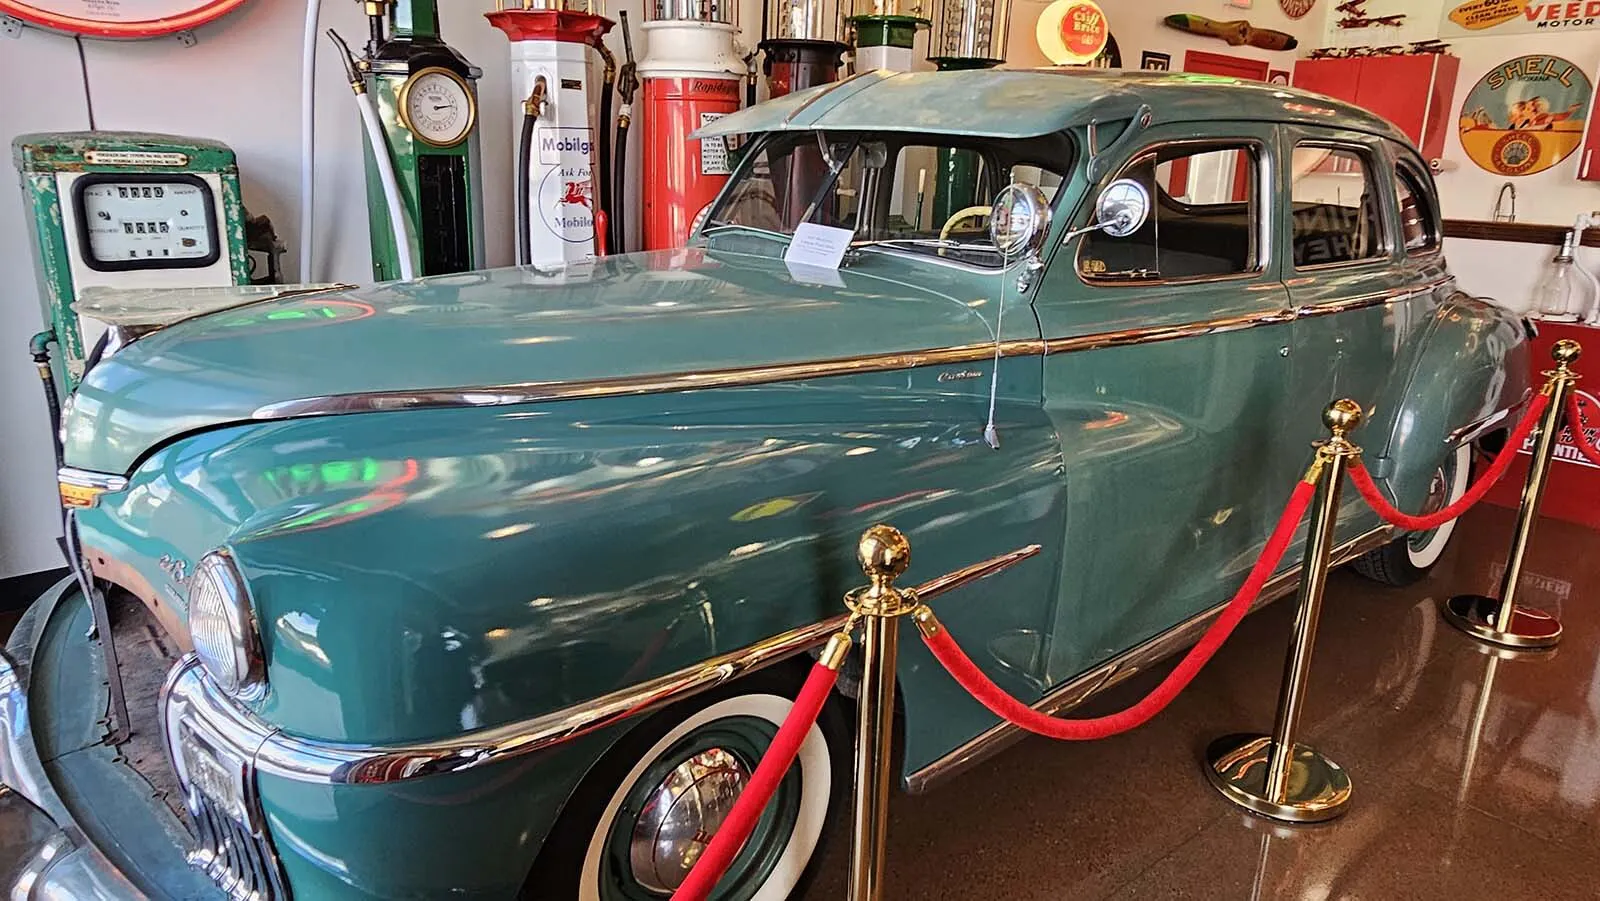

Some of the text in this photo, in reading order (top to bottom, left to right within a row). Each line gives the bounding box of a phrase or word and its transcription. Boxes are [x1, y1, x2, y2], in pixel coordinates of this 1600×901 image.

[1537, 18, 1594, 28] MOTOR
[1487, 58, 1575, 91] SHELL
[558, 168, 575, 177] Ask
